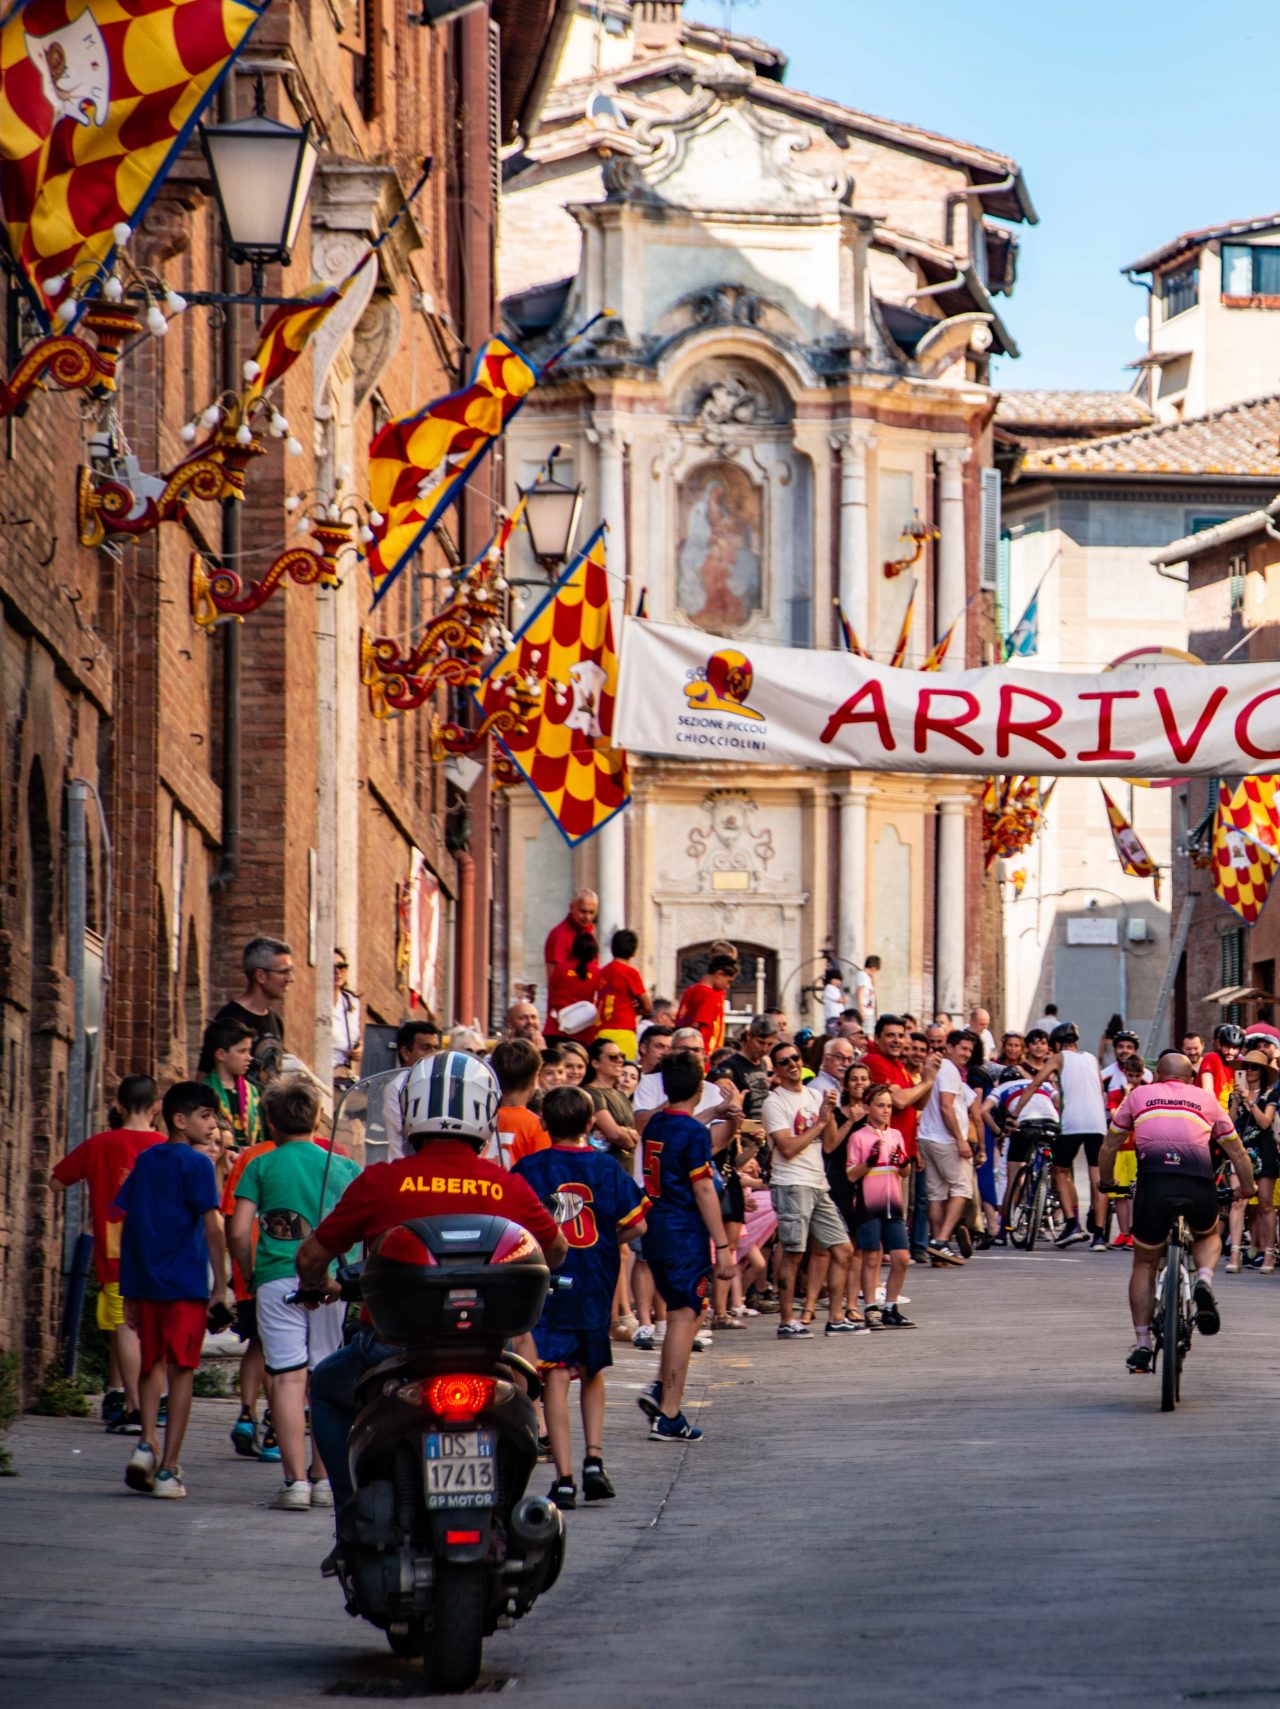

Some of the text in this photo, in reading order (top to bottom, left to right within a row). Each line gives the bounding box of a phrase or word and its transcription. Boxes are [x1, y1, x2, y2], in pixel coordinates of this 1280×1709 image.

[678, 715, 767, 735] SEZIONE PICCOLI
[676, 732, 766, 750] CHIOCCIOLINI
[643, 1139, 665, 1198] 5
[400, 1176, 503, 1200] ALBERTO
[442, 1434, 466, 1457] DS
[432, 1462, 492, 1488] 17413
[448, 1493, 493, 1508] MOTOR
